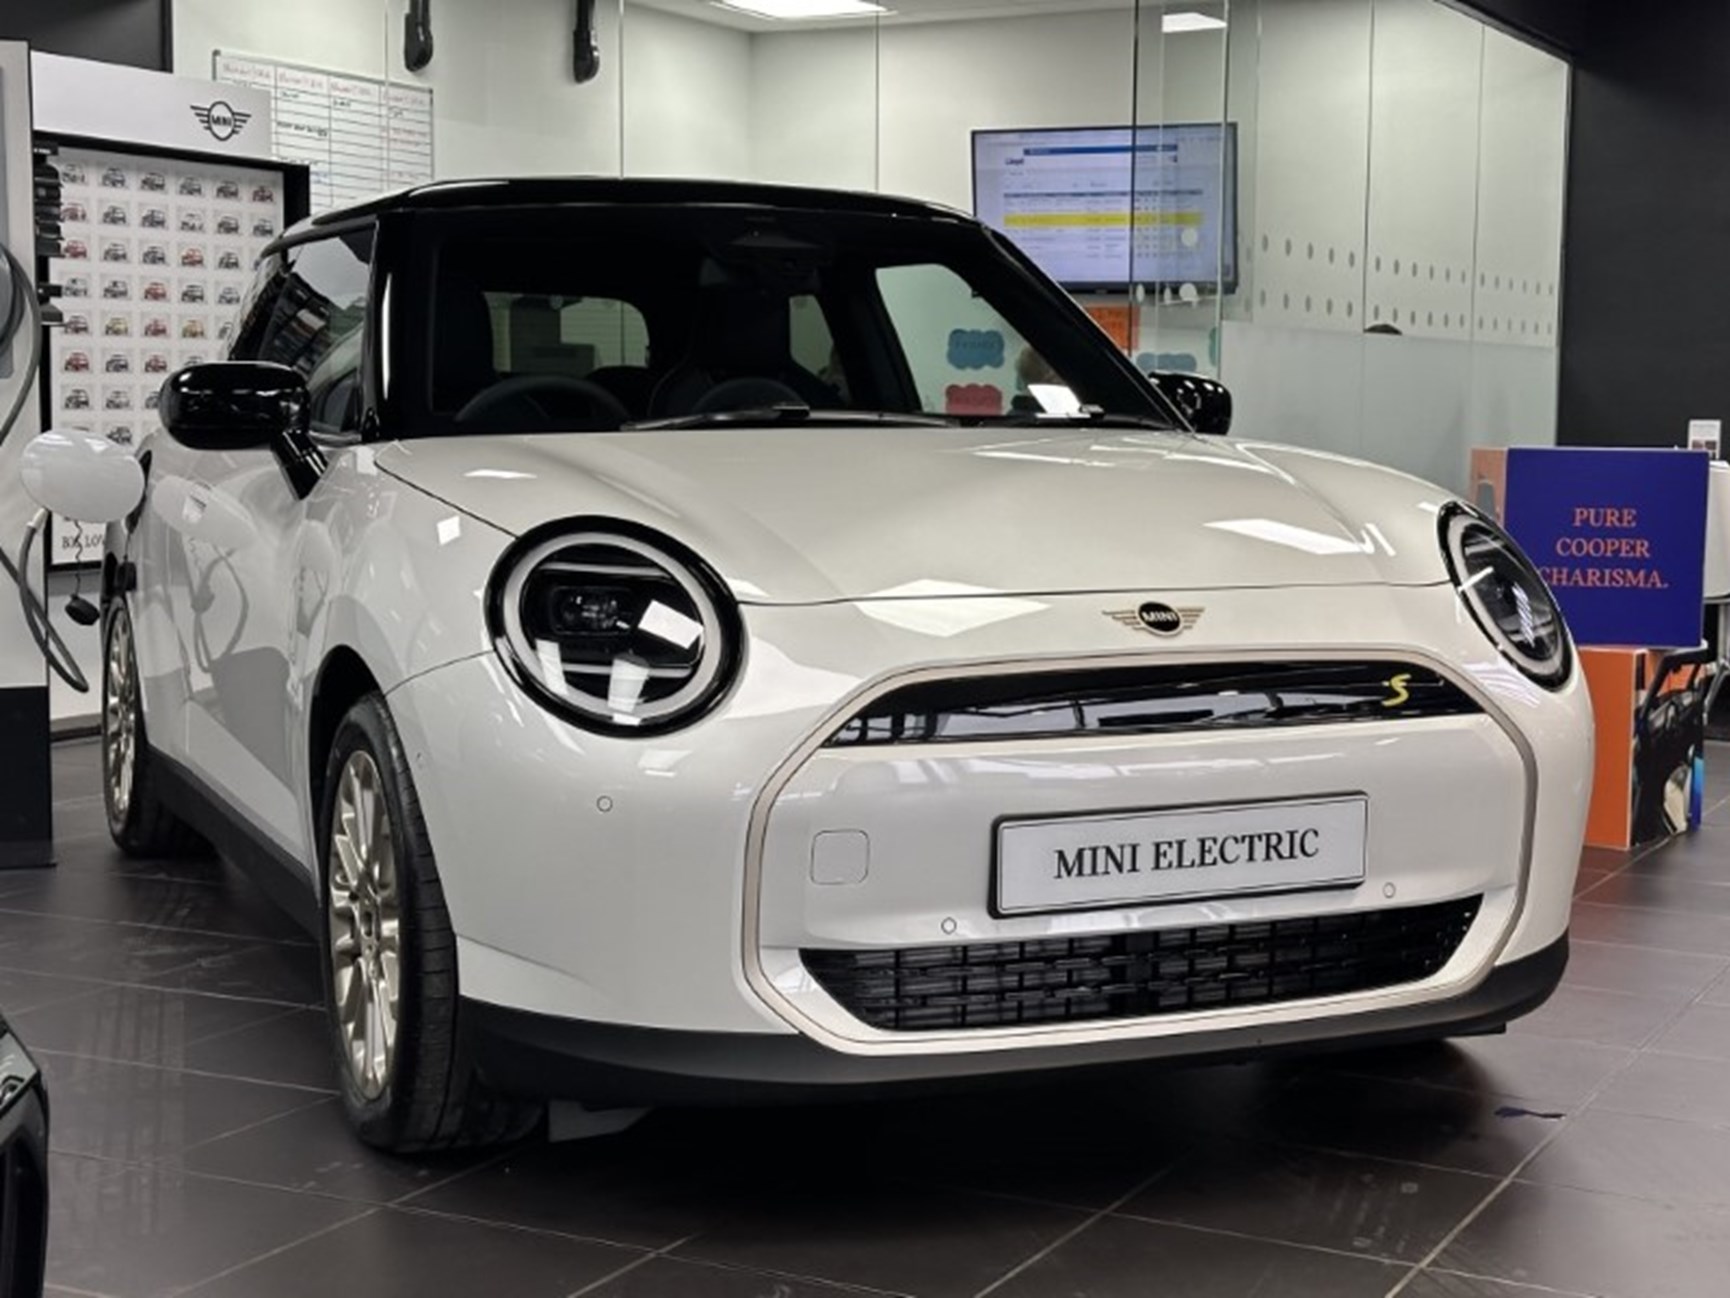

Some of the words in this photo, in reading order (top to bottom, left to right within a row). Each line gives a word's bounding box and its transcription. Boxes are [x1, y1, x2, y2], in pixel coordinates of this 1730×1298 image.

[211, 114, 233, 127] MINI
[1573, 507, 1637, 528] PURE
[1556, 537, 1650, 558] COOPER
[1141, 610, 1178, 622] MINI
[1053, 842, 1141, 879] MINI
[1151, 828, 1320, 872] ELECTRIC
